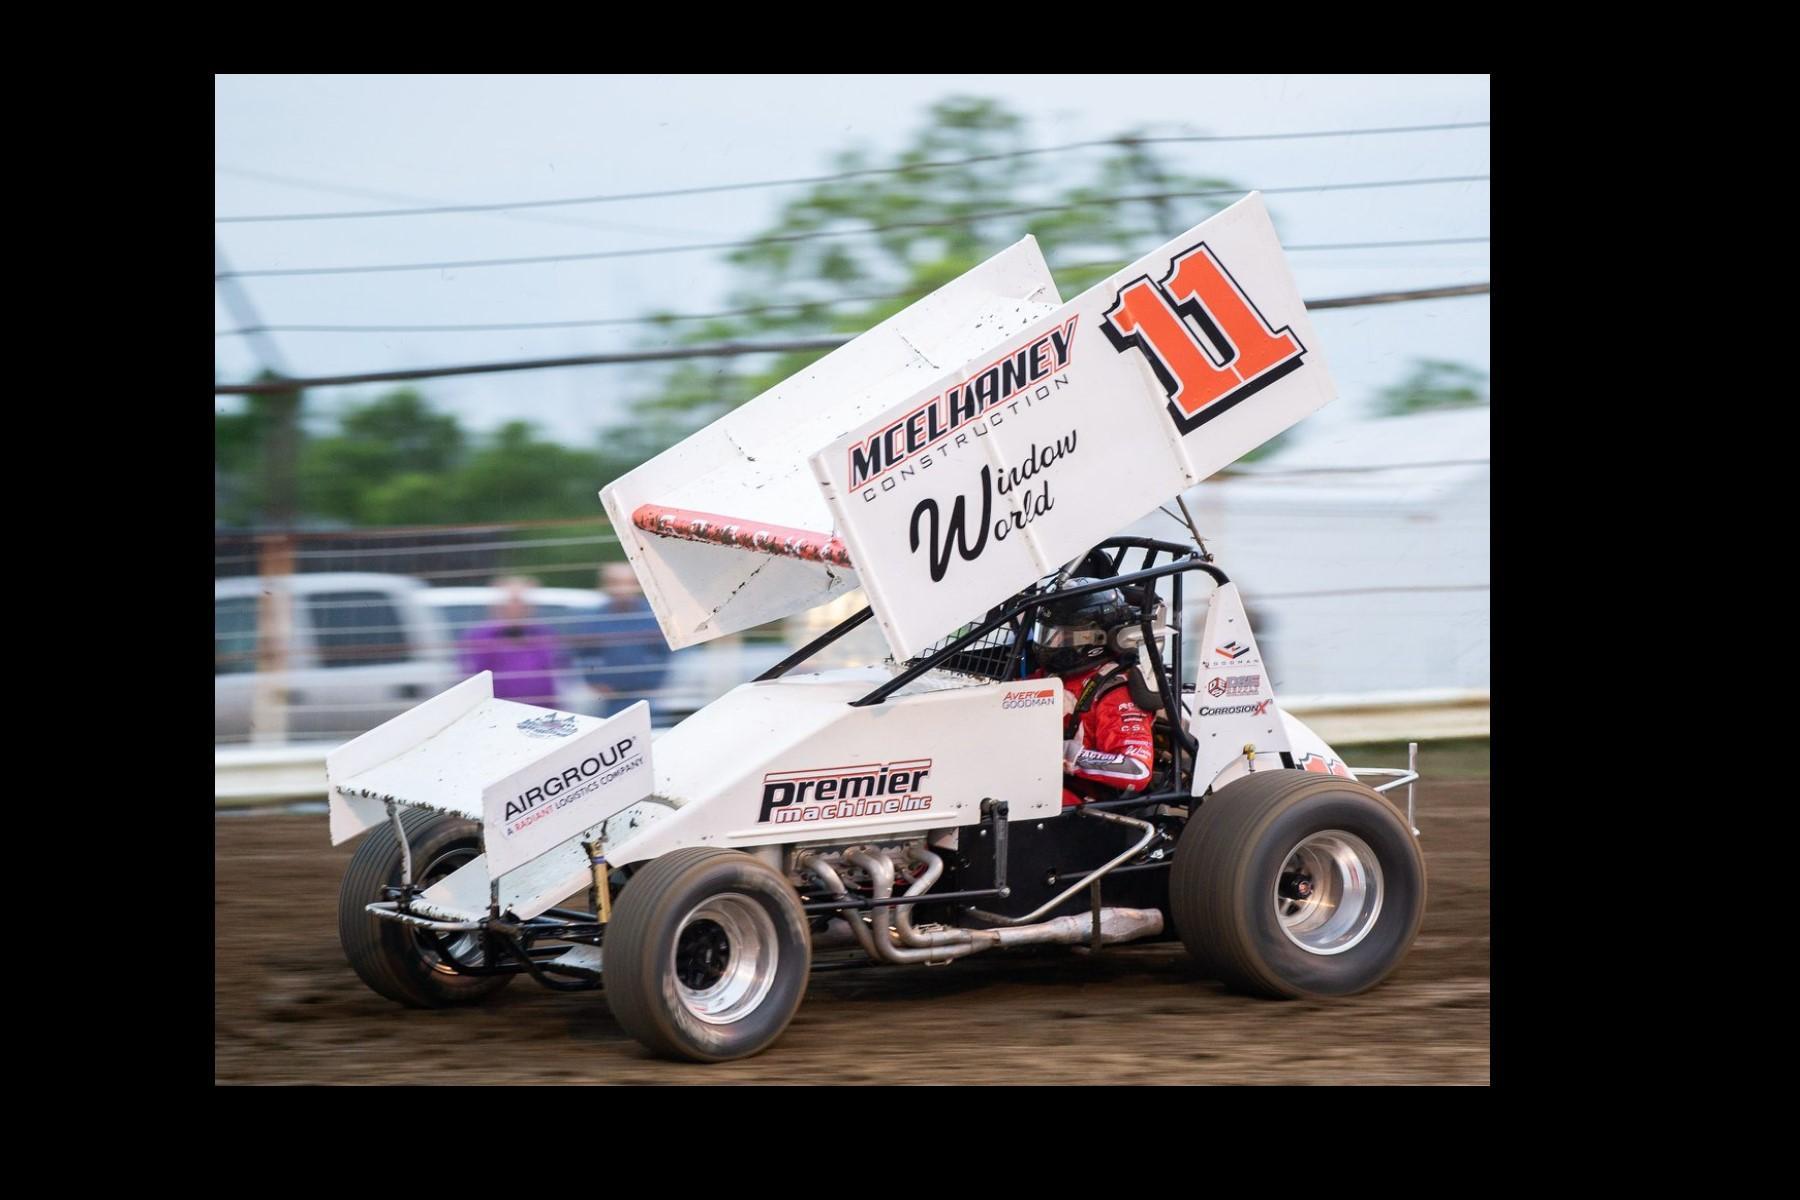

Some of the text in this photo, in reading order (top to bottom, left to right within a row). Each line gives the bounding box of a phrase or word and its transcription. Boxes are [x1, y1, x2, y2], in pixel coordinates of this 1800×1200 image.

[1100, 241, 1308, 436] 11
[848, 314, 1079, 493] MCELHANEY
[862, 373, 1070, 502] CONSTRUCTION
[1001, 698, 1055, 710] GOODMAN
[1003, 690, 1040, 701] AVERY
[504, 737, 634, 822] AIRGROUP
[506, 756, 645, 837] A RADIANT LOGISTICS COMPANY
